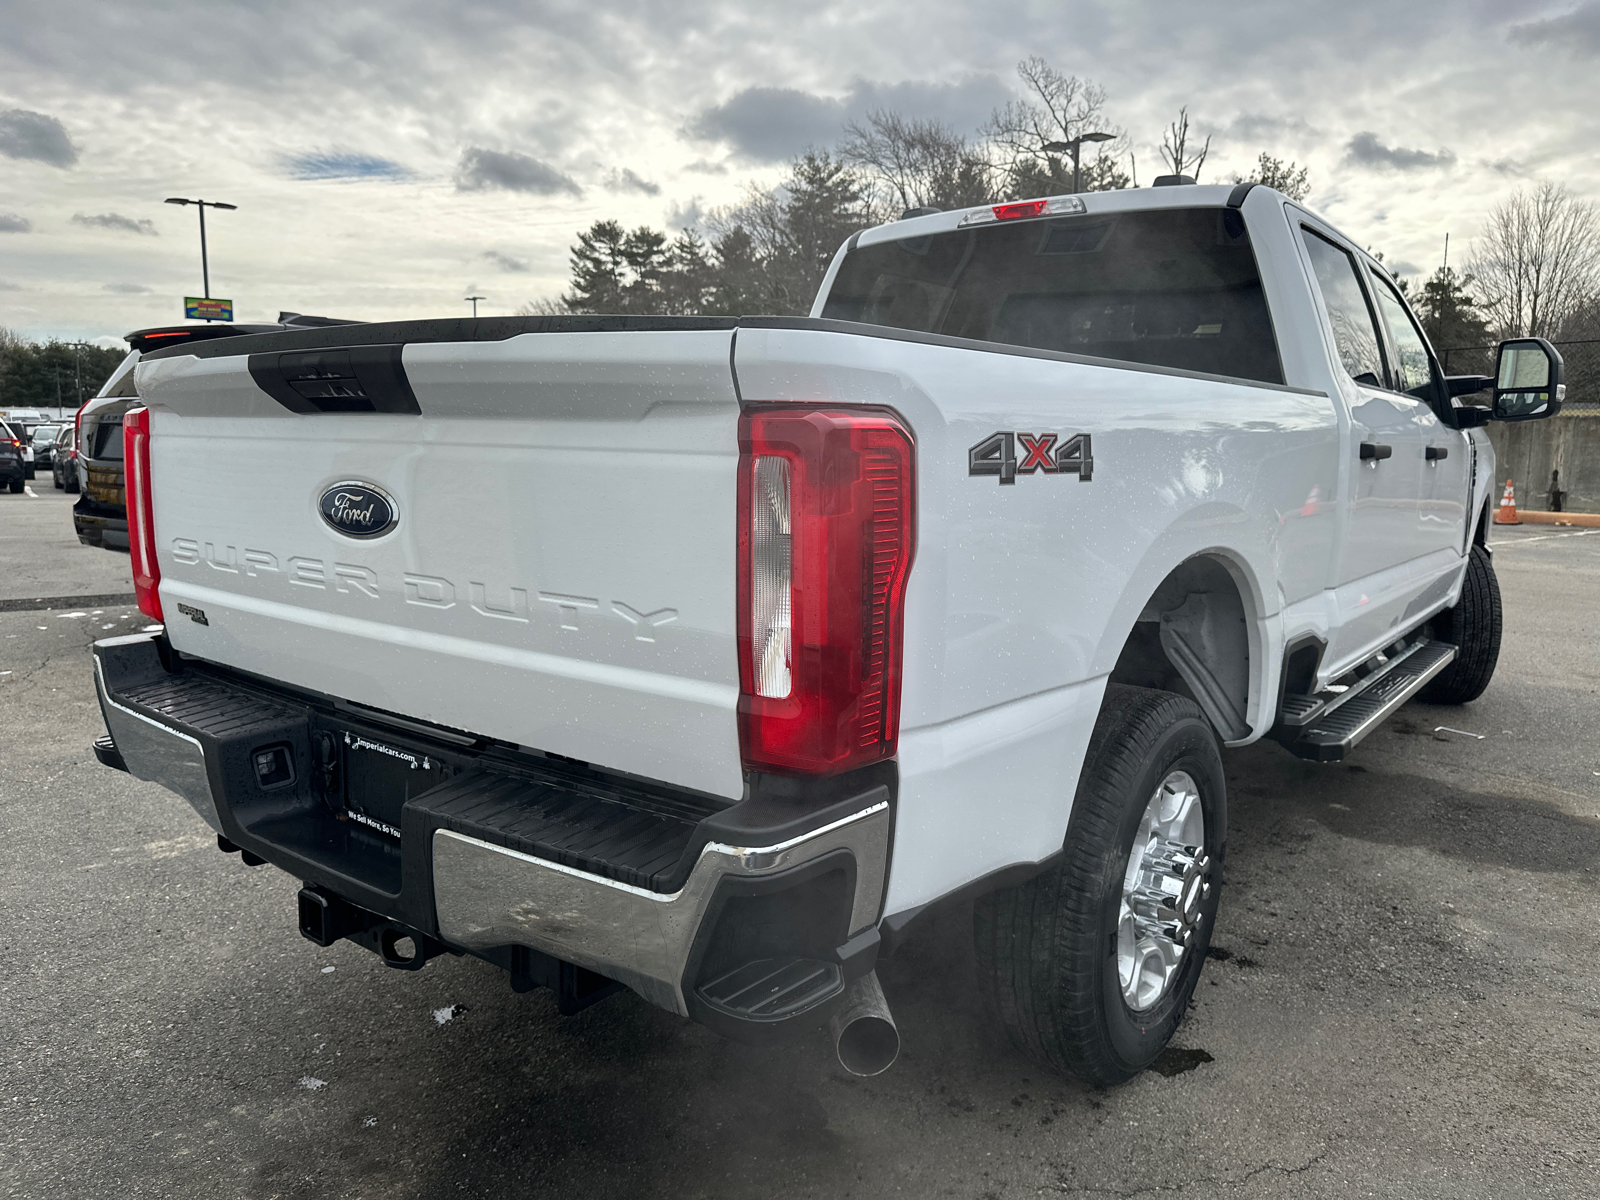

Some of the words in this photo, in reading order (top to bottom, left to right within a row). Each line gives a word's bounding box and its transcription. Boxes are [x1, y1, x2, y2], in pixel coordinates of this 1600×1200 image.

[968, 431, 1094, 486] 4X4
[331, 492, 374, 526] Ford
[172, 537, 379, 598] SUPER
[404, 571, 678, 642] DUTY
[356, 737, 416, 763] Imperialcars.com
[348, 810, 357, 820] We
[357, 814, 367, 824] Sell
[382, 824, 389, 834] So
[390, 827, 401, 838] You
